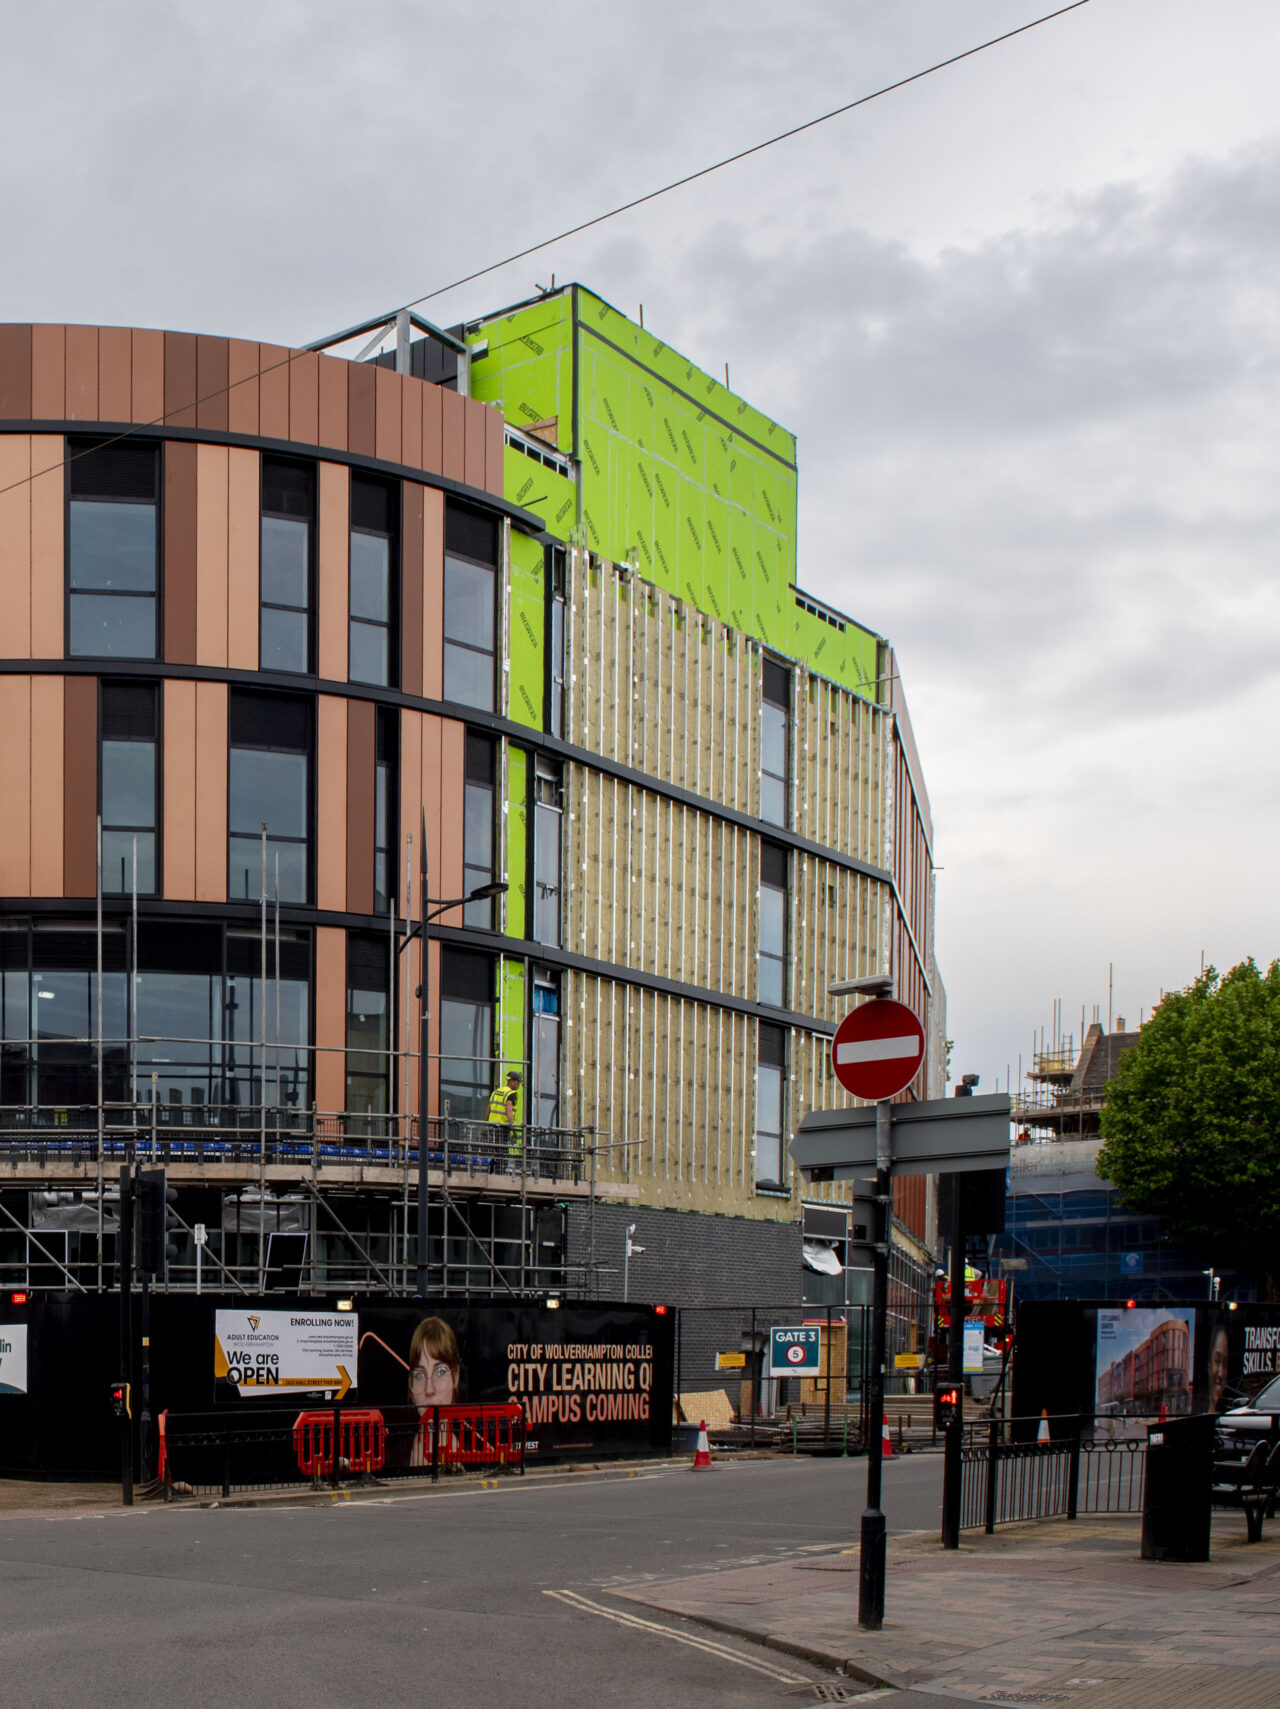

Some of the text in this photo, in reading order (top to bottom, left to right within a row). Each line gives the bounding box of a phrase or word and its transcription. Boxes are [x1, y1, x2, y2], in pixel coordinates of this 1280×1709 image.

[290, 1318, 354, 1328] ENROLLING NOW!
[776, 1332, 816, 1342] GATE 3
[227, 1351, 279, 1365] We are
[507, 1344, 529, 1360] CITY
[530, 1344, 543, 1360] OF
[544, 1344, 624, 1359] WOLVERHAMPTON
[792, 1350, 799, 1358] 5
[226, 1367, 279, 1385] OPEN
[507, 1363, 548, 1392] CITY
[552, 1363, 635, 1391] LEARNING
[508, 1393, 650, 1424] AMPUS COMING
